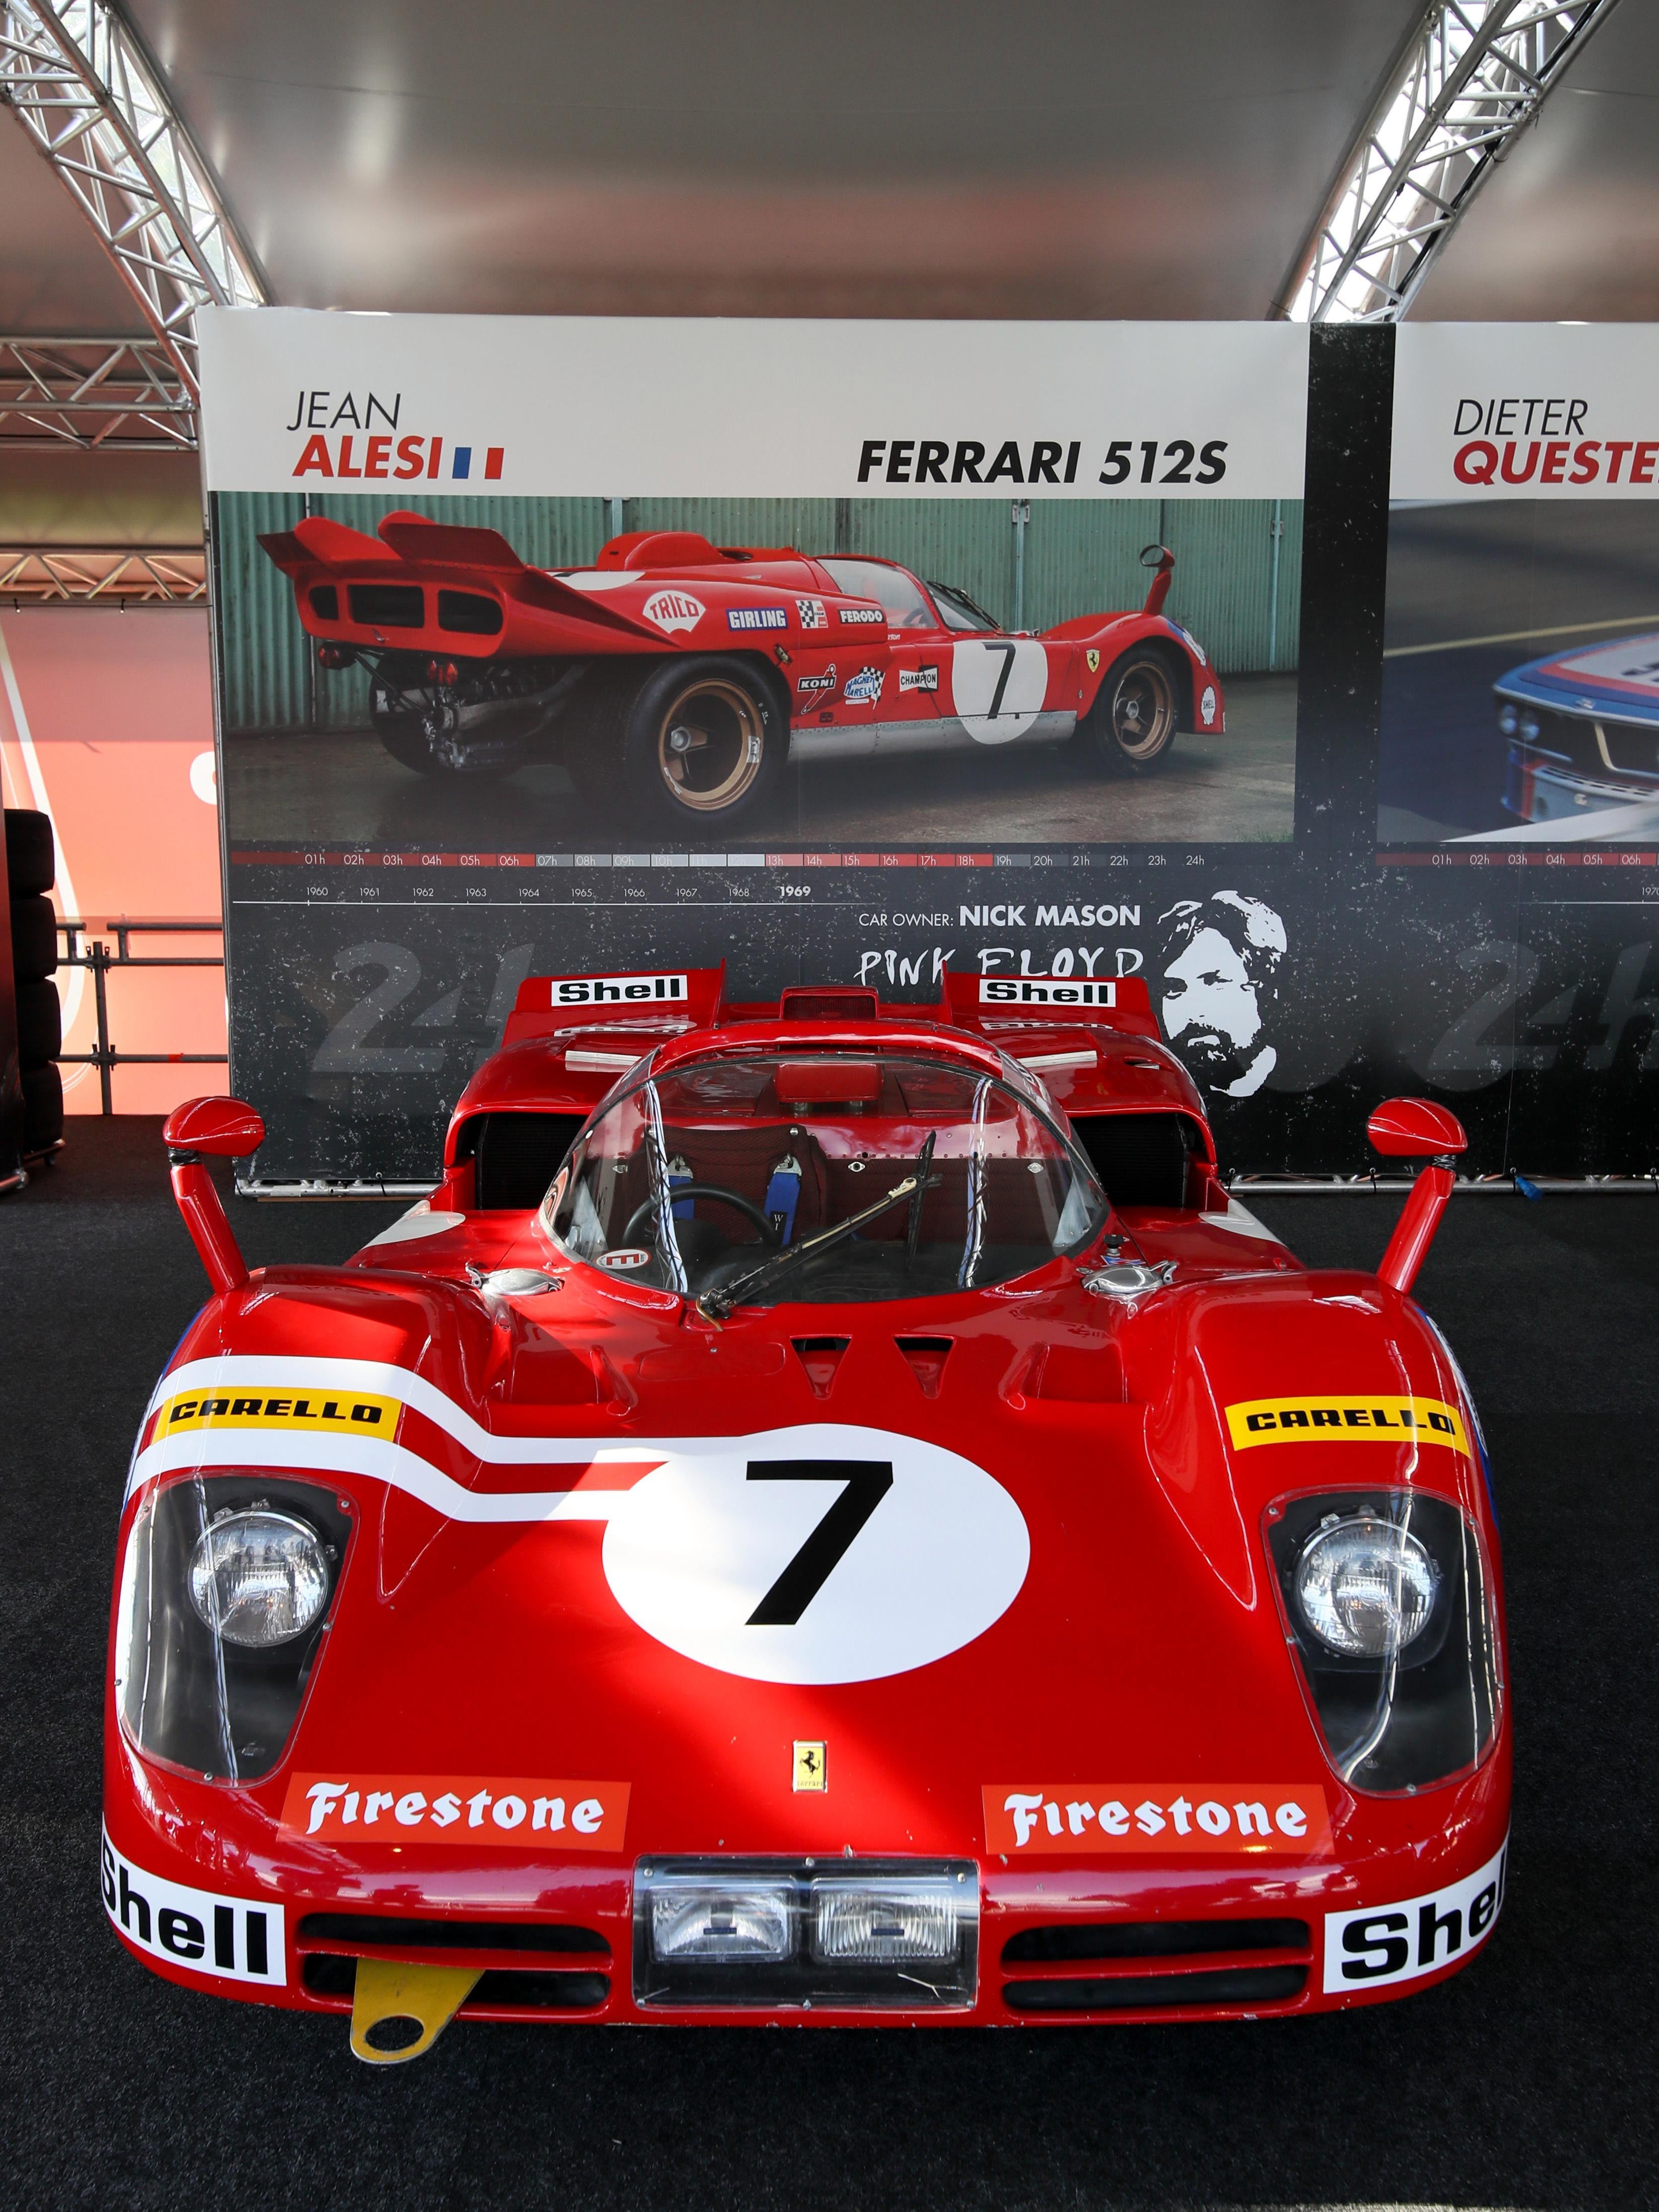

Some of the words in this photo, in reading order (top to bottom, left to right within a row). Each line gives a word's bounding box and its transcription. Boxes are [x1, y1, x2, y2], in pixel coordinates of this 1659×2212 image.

[286, 391, 400, 431] JEAN
[1454, 399, 1588, 436] DIETER
[292, 435, 443, 479] ALESI
[857, 441, 1081, 483] FERRARI
[1099, 440, 1228, 485] 512S
[1453, 441, 1659, 486] QUESTE
[650, 594, 699, 620] TRICO
[729, 610, 786, 629] GIRLING
[840, 611, 882, 623] FERODO
[801, 678, 834, 689] KONI
[901, 672, 936, 684] CHAMPION
[982, 642, 1016, 719] 7
[1203, 701, 1214, 710] SHELL
[305, 855, 325, 865] 01h
[343, 855, 364, 865] 02h
[383, 855, 403, 865] 03h
[422, 855, 442, 865] 04h
[460, 855, 480, 865] 05h
[500, 855, 519, 865] 06h
[538, 856, 557, 866] 07h
[576, 856, 596, 866] 08h
[614, 856, 634, 866] 09h
[655, 856, 672, 866] 10h
[768, 856, 783, 866] 13h
[806, 856, 822, 866] 14h
[843, 856, 859, 866] 15h
[882, 856, 898, 866] 16h
[921, 856, 936, 866] 17h
[958, 856, 974, 866] 18h
[996, 856, 1011, 866] 19h
[1034, 856, 1053, 866] 20h
[1072, 856, 1090, 866] 21h
[1110, 856, 1128, 866] 22h
[1148, 856, 1166, 866] 23h
[1186, 856, 1204, 866] 24h
[1432, 855, 1451, 865] 01h
[1470, 855, 1489, 865] 02h
[1508, 855, 1527, 865] 03h
[1546, 855, 1565, 865] 04h
[1583, 855, 1603, 865] 05h
[1622, 855, 1640, 865] 06h
[306, 887, 328, 895] 1960
[360, 887, 380, 896] 1961
[412, 887, 434, 896] 1962
[465, 887, 487, 897] 1963
[519, 888, 539, 897] 1964
[571, 888, 592, 897] 1965
[624, 888, 645, 897] 1966
[676, 888, 698, 897] 1967
[729, 888, 749, 897] 1968
[780, 885, 811, 897] 1969
[859, 913, 889, 926] CAR
[892, 913, 954, 926] OWNER:
[960, 906, 1026, 926] NICK
[1034, 905, 1141, 927] MASON
[854, 947, 956, 986] PINK
[978, 947, 1143, 978] FLOYD
[559, 979, 680, 1002] Shell
[987, 982, 1108, 1004] Shell
[169, 1399, 382, 1424] CARELLO
[1247, 1409, 1456, 1435] CARELLO
[744, 1460, 893, 1626] 7
[306, 1782, 604, 1835] Firestone
[1004, 1792, 1307, 1847] Firestone
[102, 1833, 268, 1975] Shell
